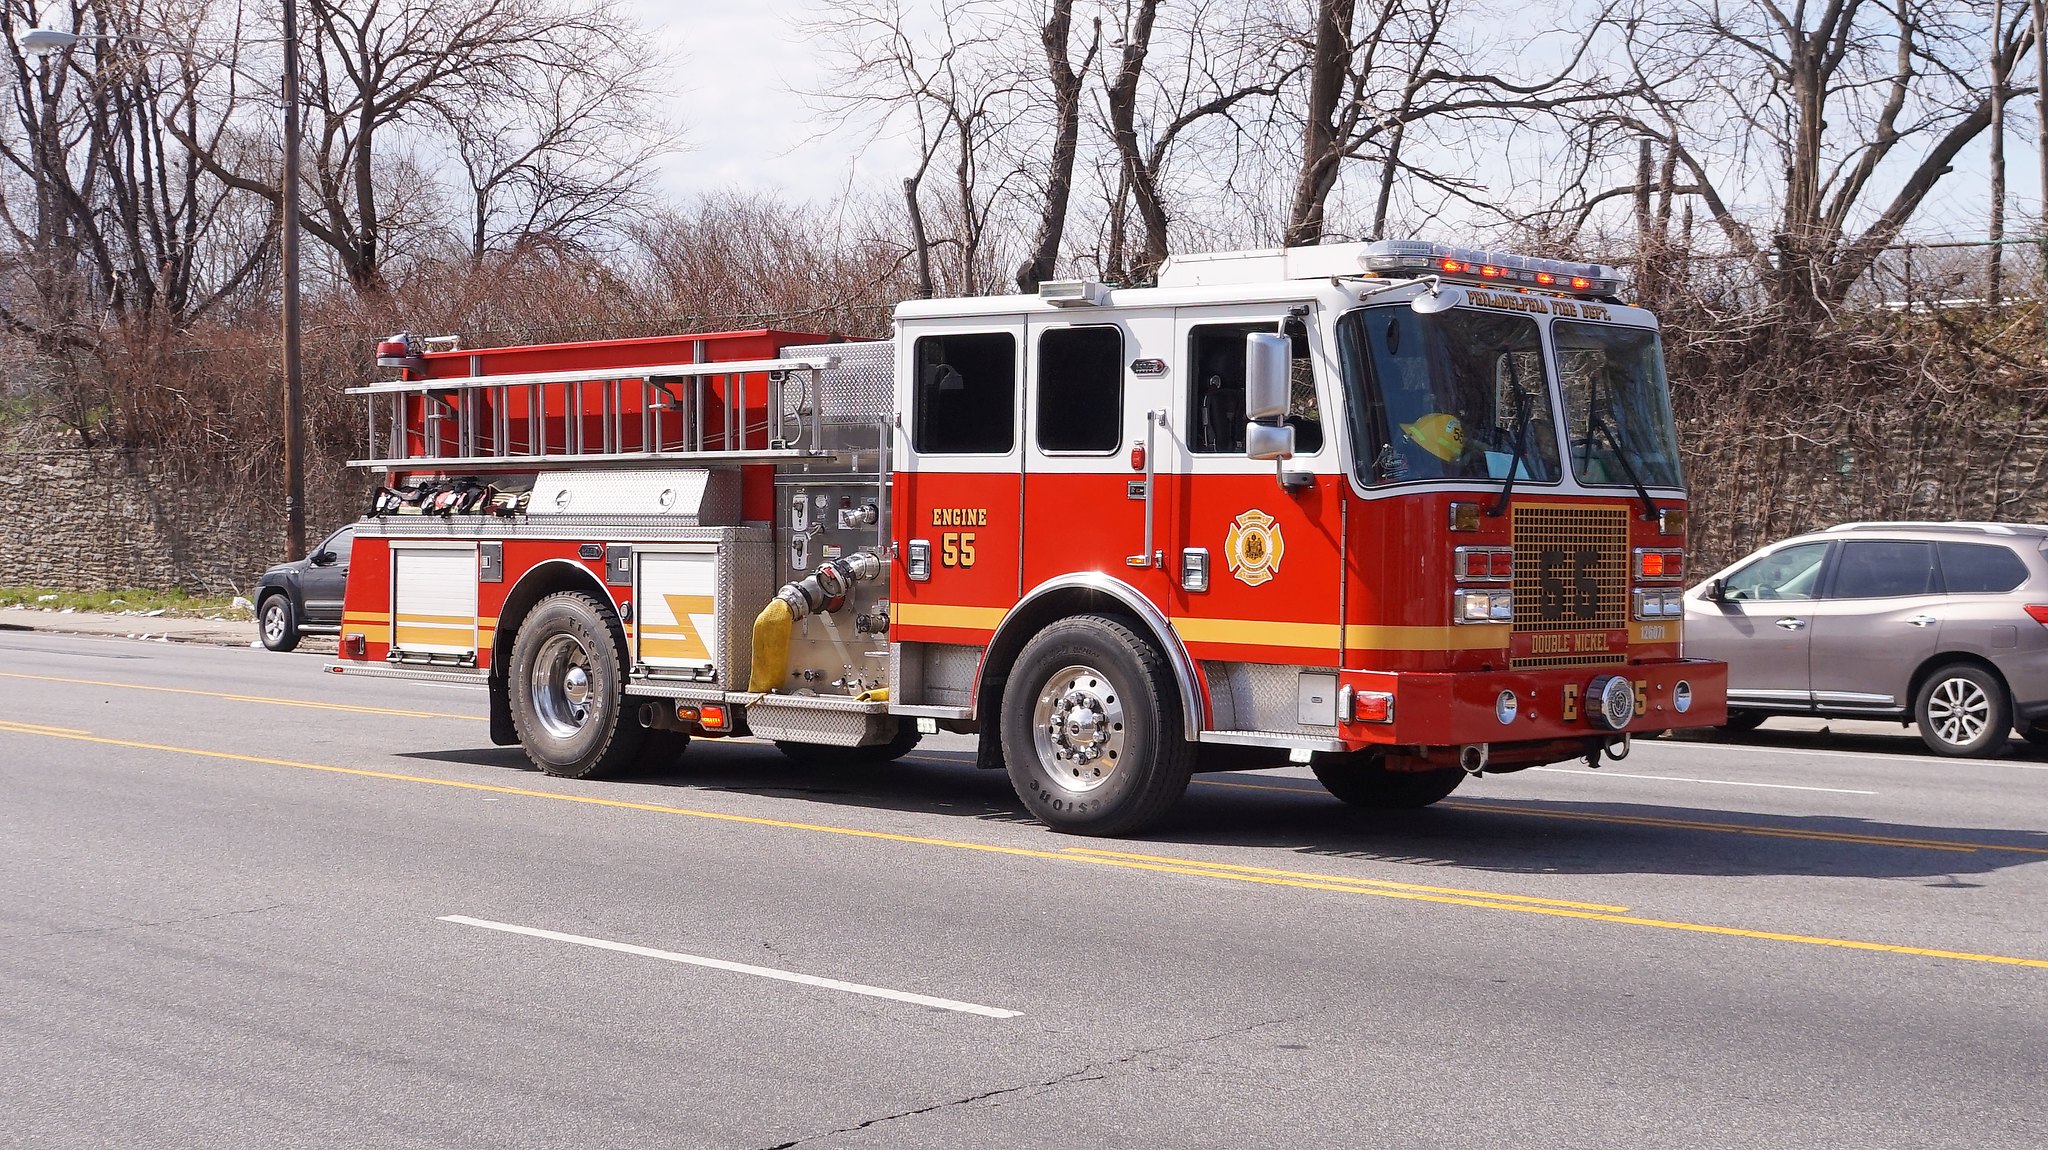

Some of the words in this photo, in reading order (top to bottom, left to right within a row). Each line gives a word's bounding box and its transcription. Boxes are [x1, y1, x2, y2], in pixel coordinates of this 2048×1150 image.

[1466, 290, 1548, 314] PHILADELPHIA
[1550, 300, 1577, 317] FIRE
[1580, 303, 1611, 321] DEPT.
[932, 508, 987, 526] ENGINE
[942, 532, 976, 568] 55
[1541, 551, 1598, 618] 55
[1531, 634, 1570, 654] DOUBLE
[1574, 633, 1610, 652] NICKEL
[1640, 625, 1665, 639] 126071
[1562, 684, 1578, 720] E
[1629, 680, 1647, 716] 5
